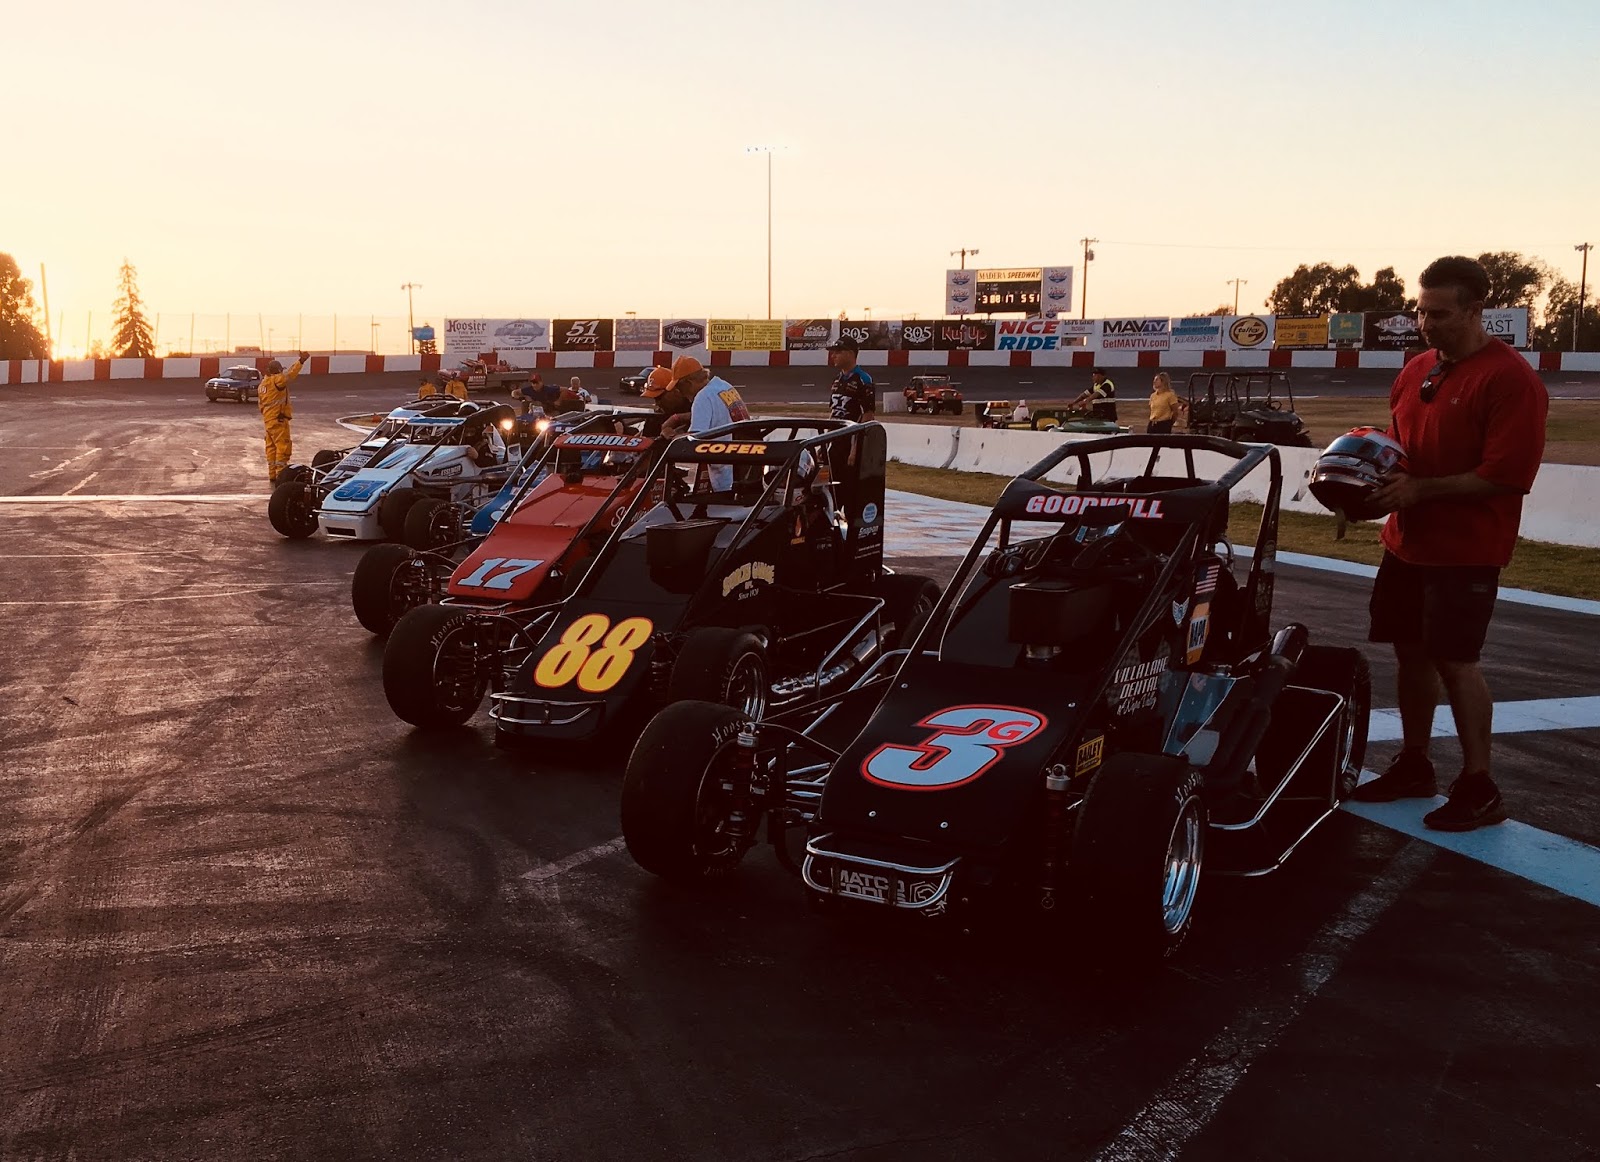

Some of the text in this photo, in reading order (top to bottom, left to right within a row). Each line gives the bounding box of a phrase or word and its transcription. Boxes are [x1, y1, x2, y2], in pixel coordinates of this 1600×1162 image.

[1007, 271, 1040, 279] SPEEDWAY
[446, 320, 487, 332] Hoosier
[566, 320, 600, 336] 51
[669, 326, 698, 334] Hampton
[998, 321, 1061, 334] NICE
[1103, 320, 1168, 333] MAVTV
[1482, 319, 1513, 333] AST
[903, 326, 932, 340] 805
[564, 336, 600, 344] FIFTY
[997, 336, 1060, 350] RIDE
[1103, 339, 1168, 348] GetMAVTV.com
[563, 434, 644, 447] NICHOLS
[694, 443, 768, 455] COFER
[333, 479, 388, 502] 51
[456, 557, 545, 590] 17
[534, 613, 654, 693] 88
[711, 719, 747, 749] Hoos
